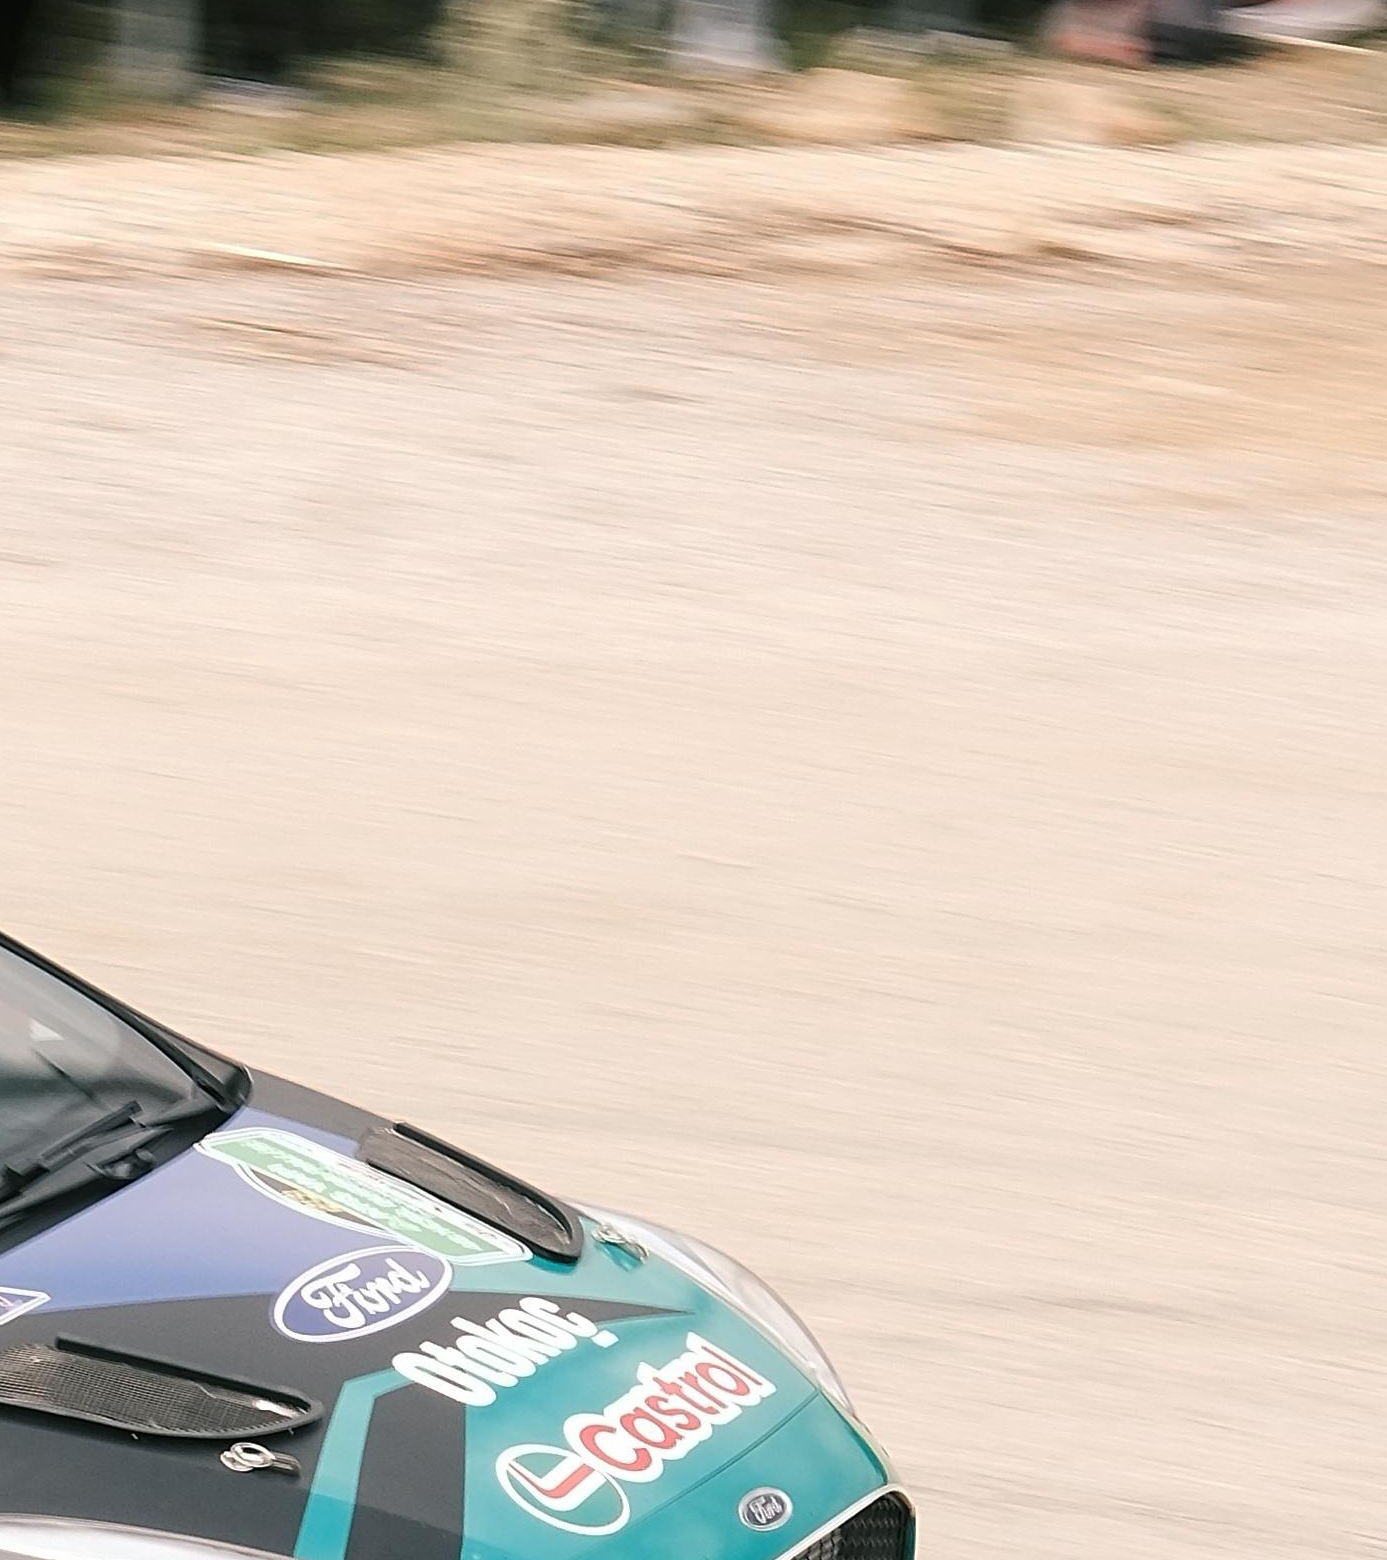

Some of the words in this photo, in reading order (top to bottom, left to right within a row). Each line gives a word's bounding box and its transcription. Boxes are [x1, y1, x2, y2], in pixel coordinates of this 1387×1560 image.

[301, 1257, 431, 1329] Ford
[392, 1296, 619, 1407] Otokoç
[574, 1340, 768, 1475] Castrol
